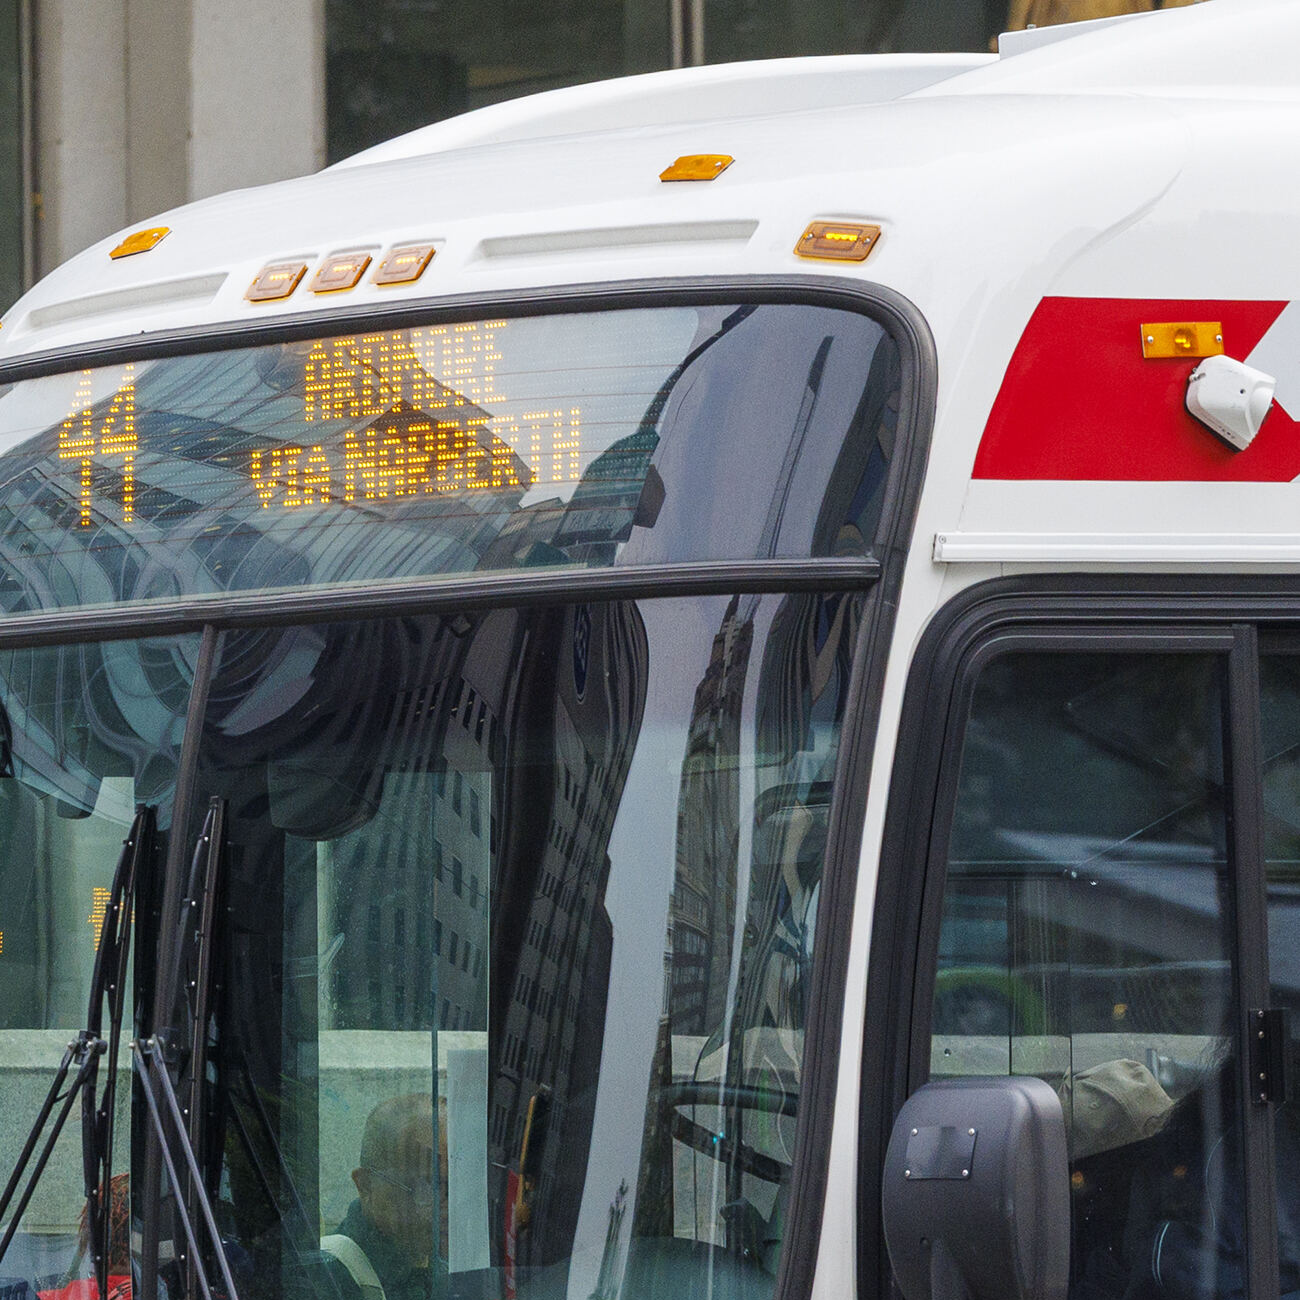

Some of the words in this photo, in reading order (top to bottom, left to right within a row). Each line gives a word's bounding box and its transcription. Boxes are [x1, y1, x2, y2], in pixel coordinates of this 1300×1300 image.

[304, 321, 507, 421] ARDMORE
[59, 364, 138, 526] 44
[250, 444, 331, 508] VIA
[343, 405, 582, 501] NARBERTH
